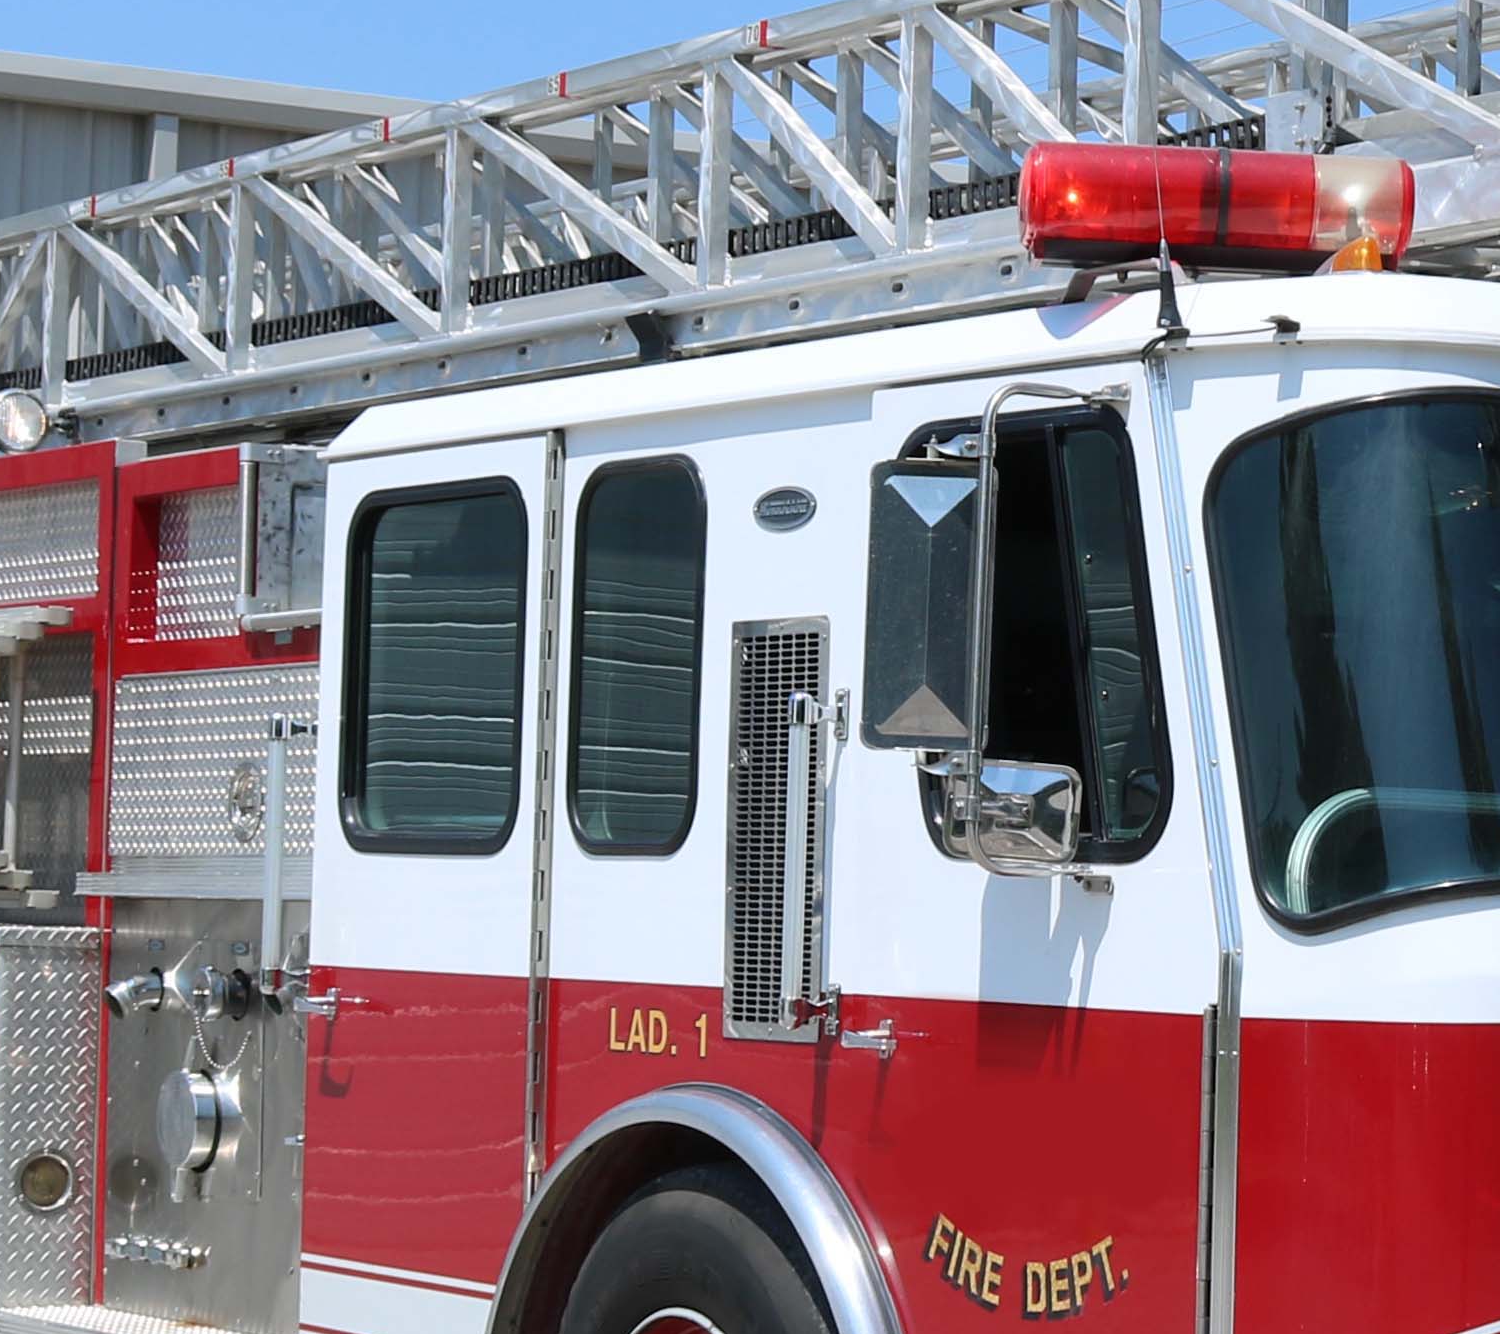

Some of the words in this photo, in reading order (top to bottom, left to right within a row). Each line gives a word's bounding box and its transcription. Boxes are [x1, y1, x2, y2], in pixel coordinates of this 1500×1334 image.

[747, 25, 759, 44] 70
[609, 1007, 677, 1055] LAD.
[695, 1013, 707, 1058] 1
[925, 1212, 1004, 1309] FIRE
[1024, 1234, 1129, 1317] DEPT.
